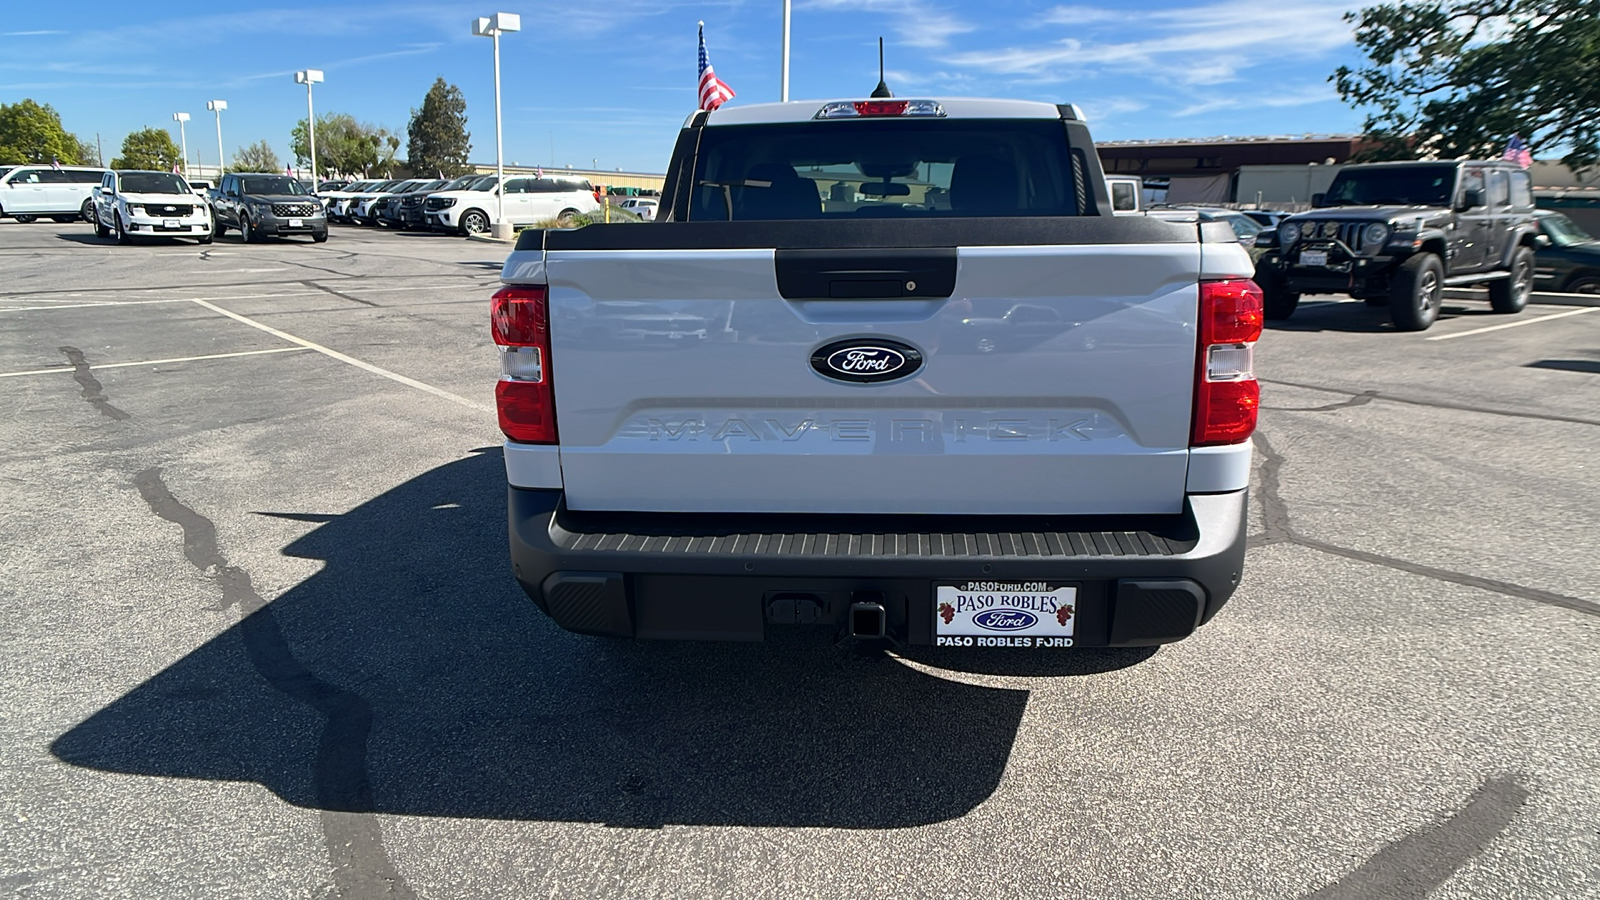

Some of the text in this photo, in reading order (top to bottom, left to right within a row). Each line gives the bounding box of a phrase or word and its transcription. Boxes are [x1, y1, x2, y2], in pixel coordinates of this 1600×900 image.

[842, 350, 890, 370] Ford
[648, 418, 1094, 443] MAVERICK
[967, 581, 1047, 592] PASOFORD.COM
[956, 595, 1058, 614] PASO ROBLES
[986, 612, 1027, 627] Ford
[936, 636, 1074, 648] PASO ROBLES FORD
